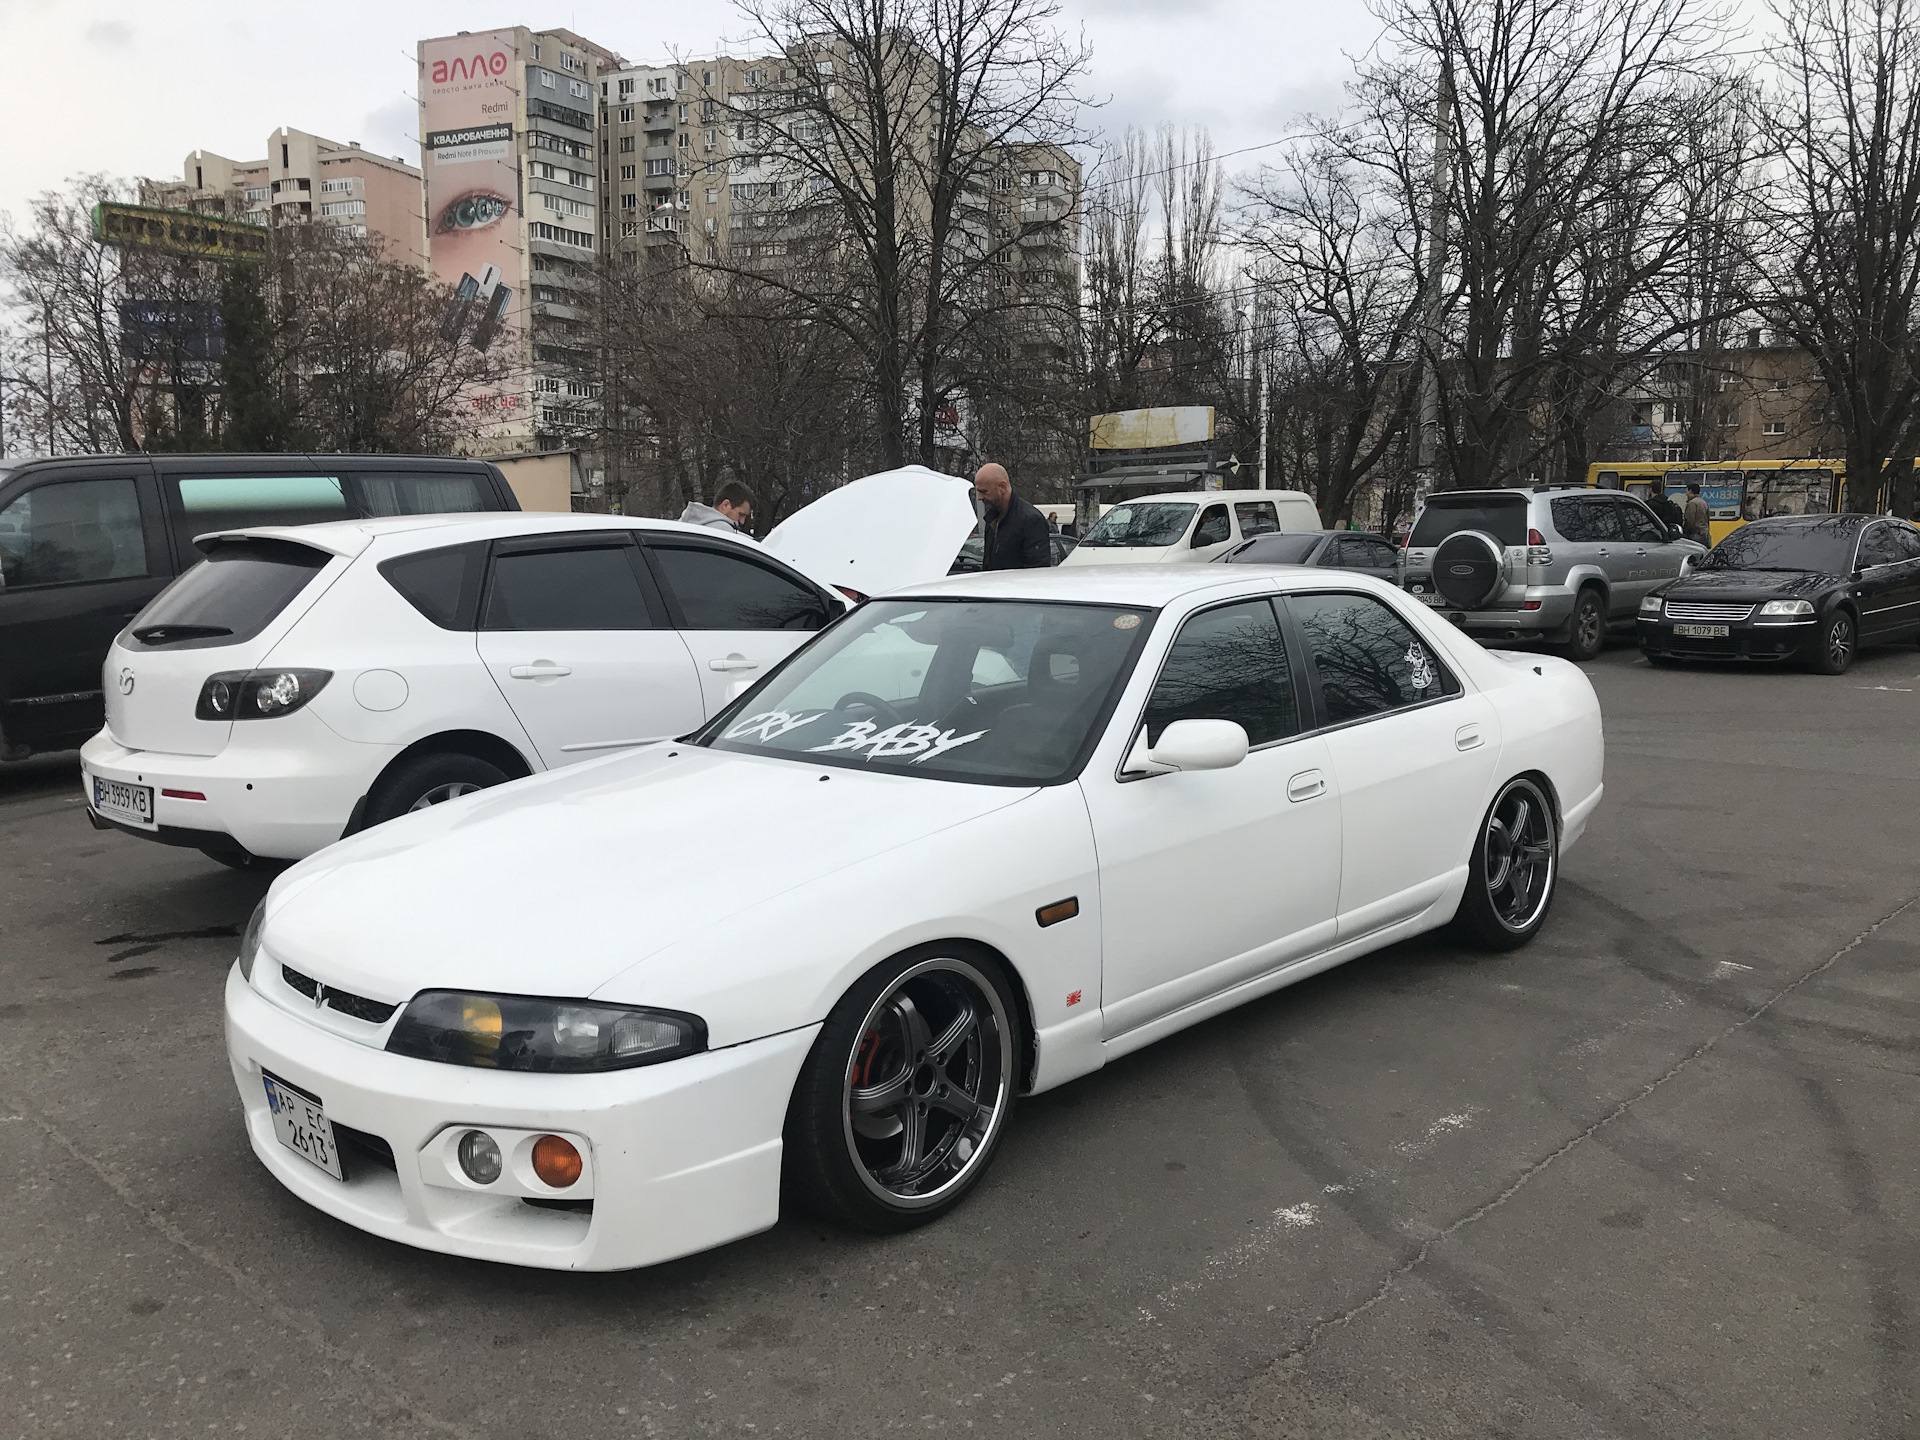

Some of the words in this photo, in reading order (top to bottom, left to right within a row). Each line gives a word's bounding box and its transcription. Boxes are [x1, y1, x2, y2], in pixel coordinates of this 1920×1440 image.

[432, 87, 460, 95] ПРОСТО
[481, 101, 508, 114] Redmi
[433, 128, 509, 145] КВАДРОБАЧЕННЯ
[438, 151, 457, 160] Redmi
[458, 150, 472, 158] Note
[478, 148, 488, 156] Pro
[1679, 625, 1690, 634] BH
[1692, 626, 1711, 635] 1079
[1713, 626, 1726, 636] BE
[724, 708, 827, 744] CRY
[800, 716, 991, 765] BABY
[99, 780, 111, 804] BH
[111, 784, 130, 808] 3959
[131, 789, 147, 812] KB
[278, 1091, 295, 1114] AP
[305, 1107, 326, 1134] EC
[288, 1119, 328, 1165] 2613
